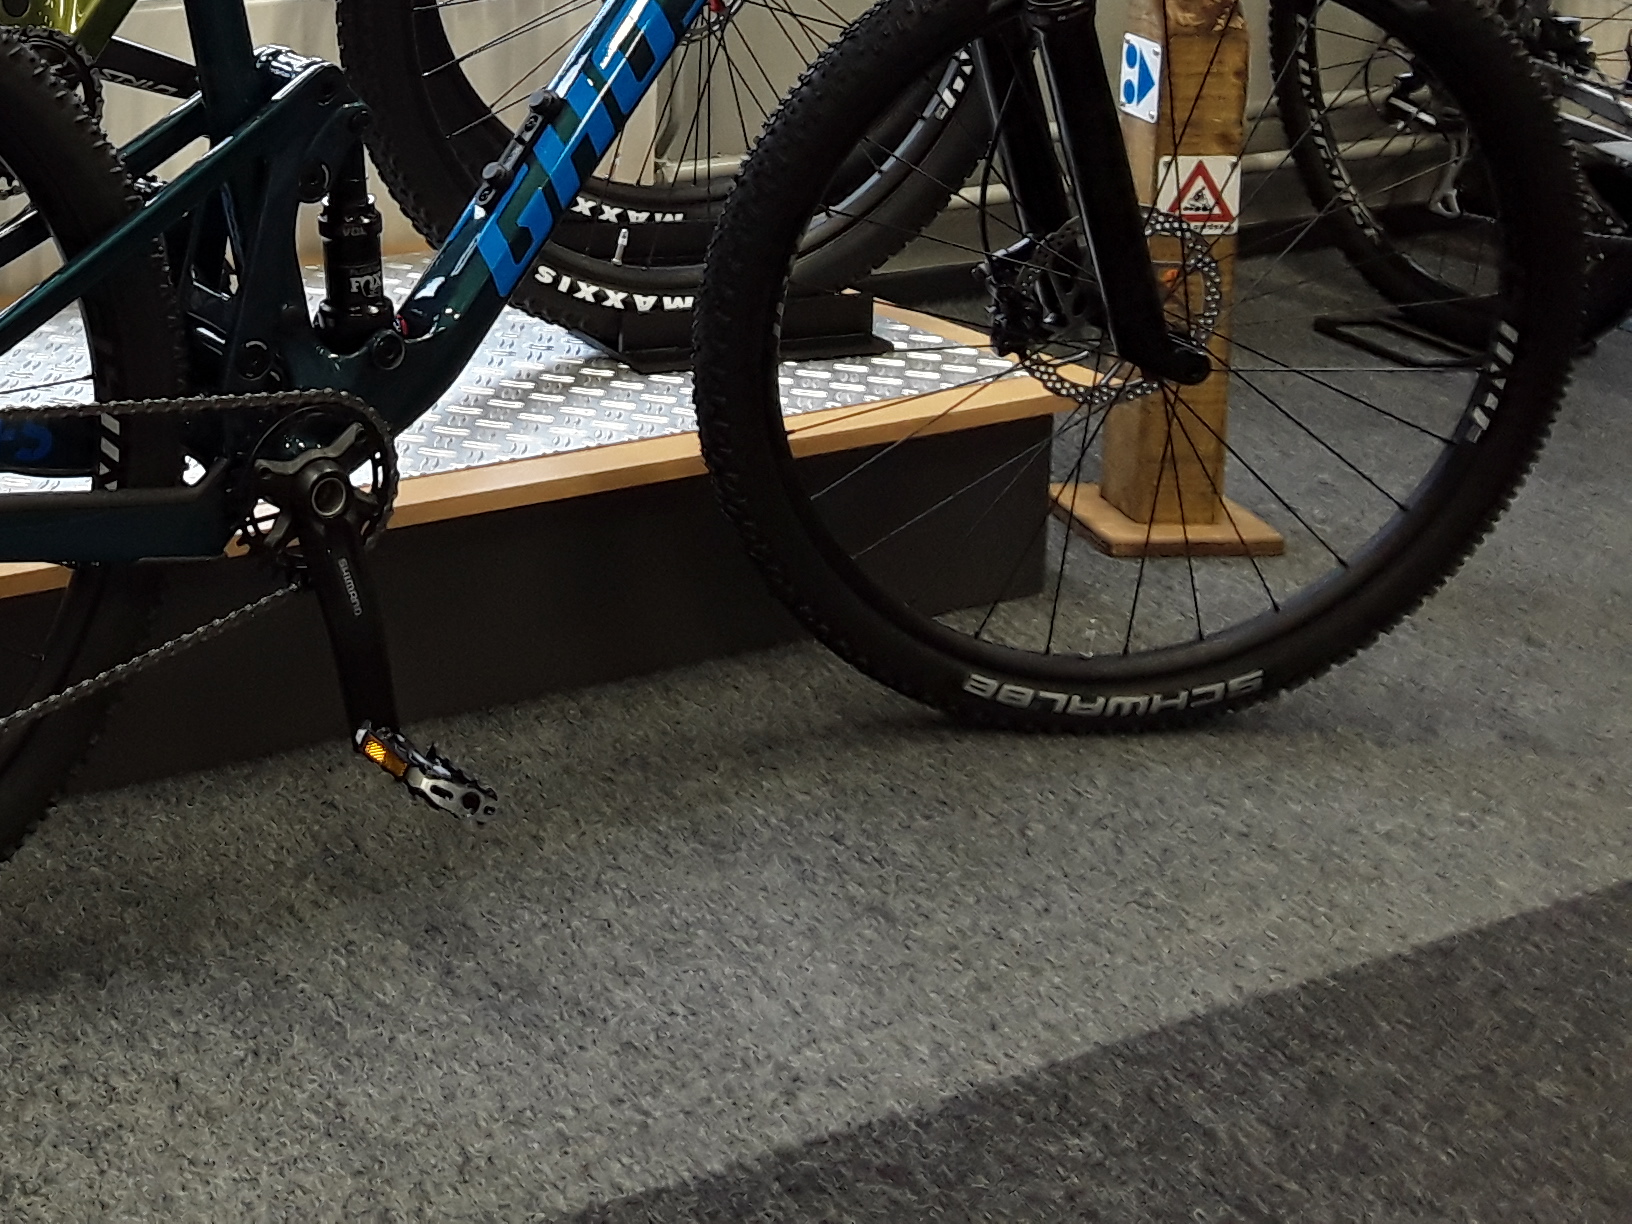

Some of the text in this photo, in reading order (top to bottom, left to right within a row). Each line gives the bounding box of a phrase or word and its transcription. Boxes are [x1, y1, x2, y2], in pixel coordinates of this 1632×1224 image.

[569, 195, 685, 224] MAXX
[534, 264, 696, 314] MAXXIS
[337, 557, 363, 616] SHIMANO
[963, 667, 1265, 717] SCHWALBE
